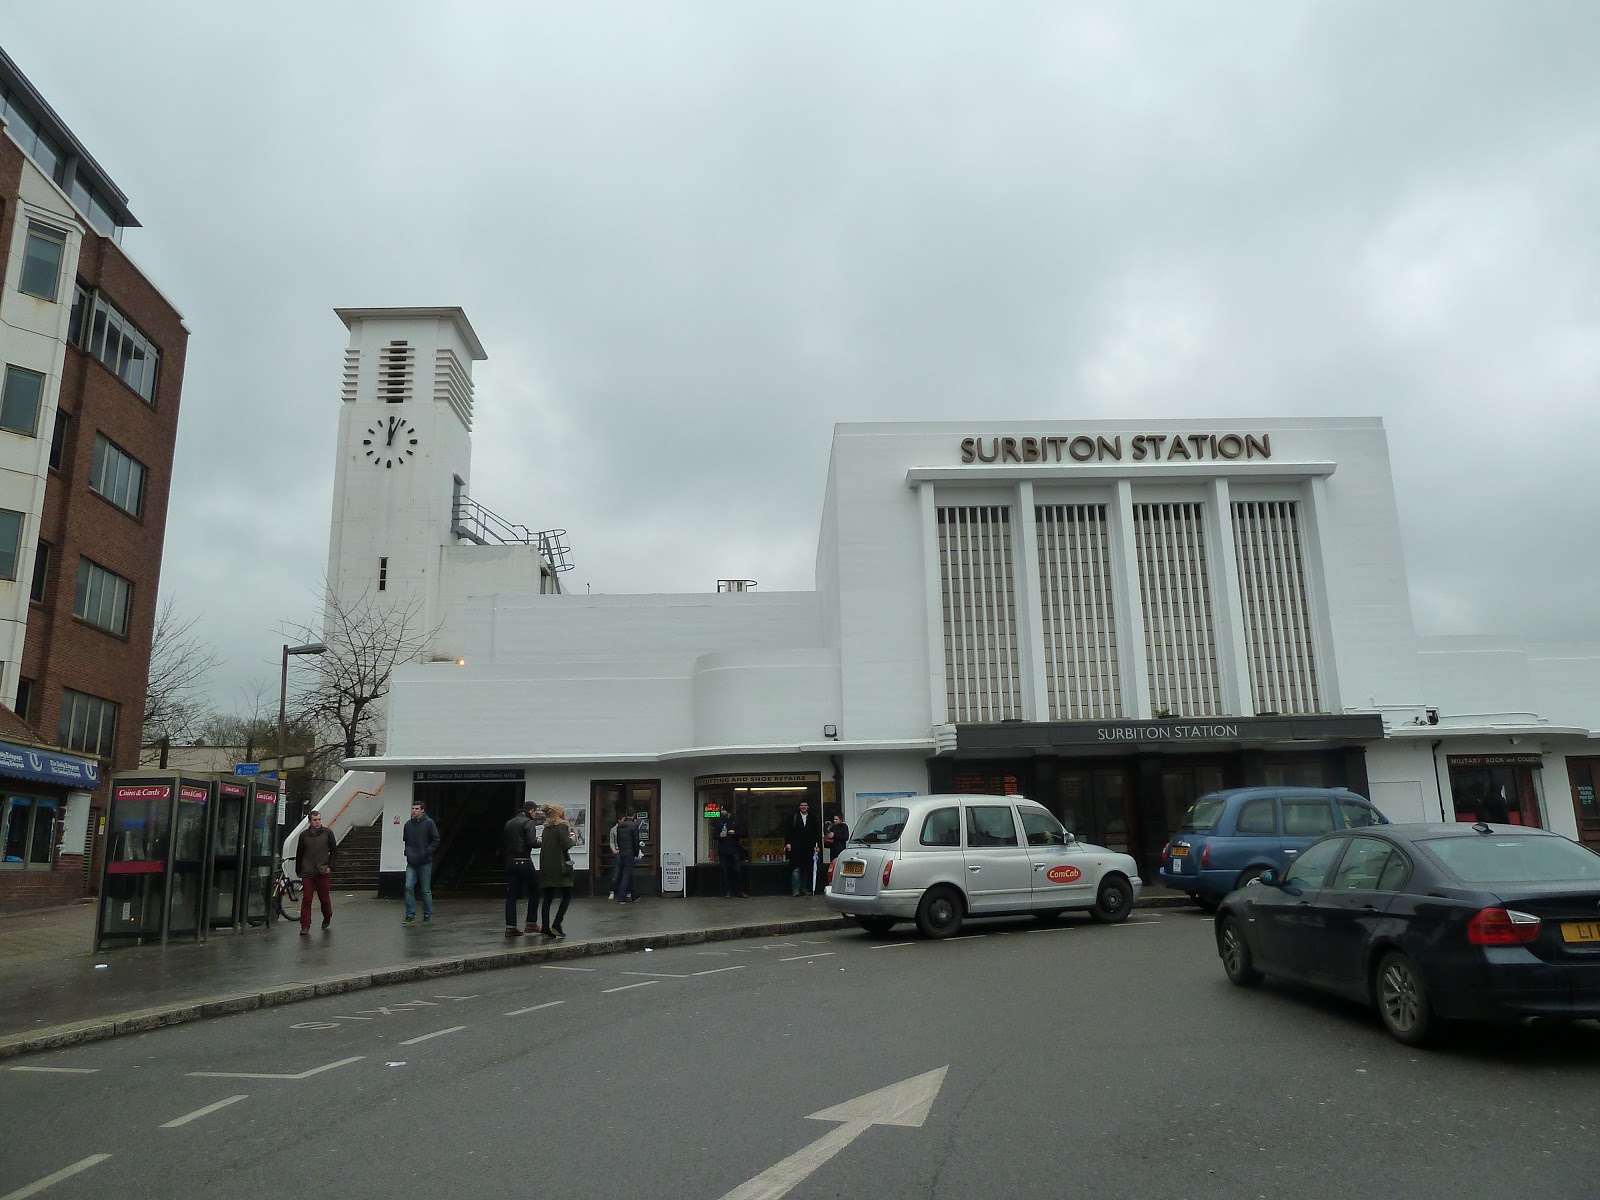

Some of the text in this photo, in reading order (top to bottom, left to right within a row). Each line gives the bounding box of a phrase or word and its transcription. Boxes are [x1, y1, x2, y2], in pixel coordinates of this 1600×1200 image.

[961, 433, 1272, 463] SURBITON STATION
[1098, 725, 1238, 740] SURBITON STATION
[751, 775, 771, 783] SHOE
[774, 774, 806, 782] REPAIRS
[119, 788, 136, 797] Coins
[142, 788, 160, 796] Cards
[1049, 868, 1079, 878] ComCab
